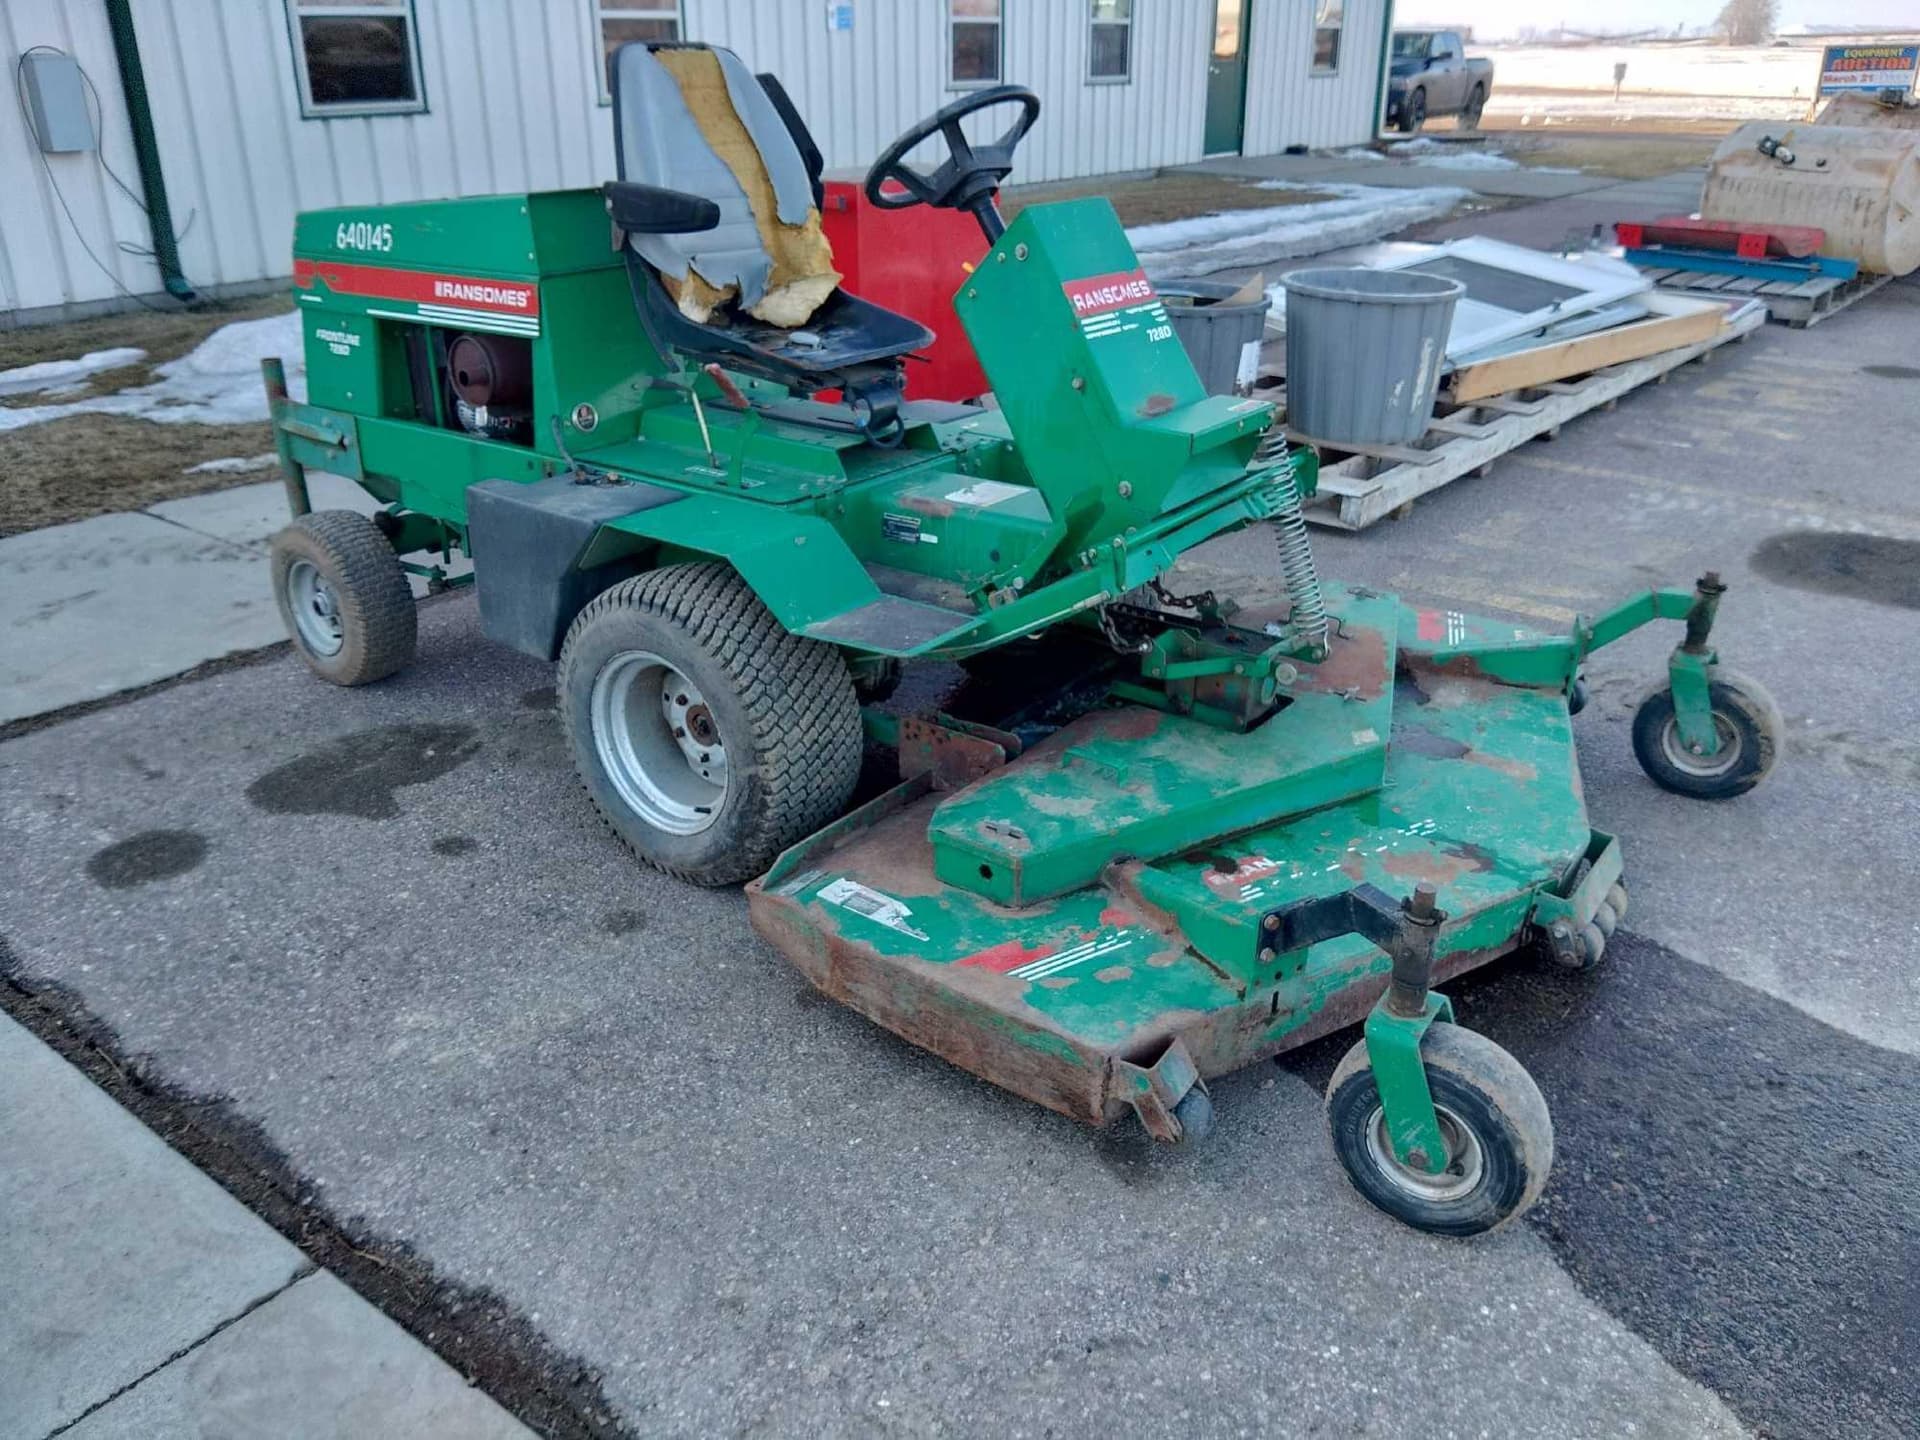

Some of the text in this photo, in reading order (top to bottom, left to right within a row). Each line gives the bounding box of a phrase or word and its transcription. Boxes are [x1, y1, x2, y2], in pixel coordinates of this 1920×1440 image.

[1843, 48, 1904, 58] EQUIPMENT
[1832, 57, 1911, 71] AUCTION
[336, 223, 393, 252] 640145
[443, 281, 528, 308] RANSOMES
